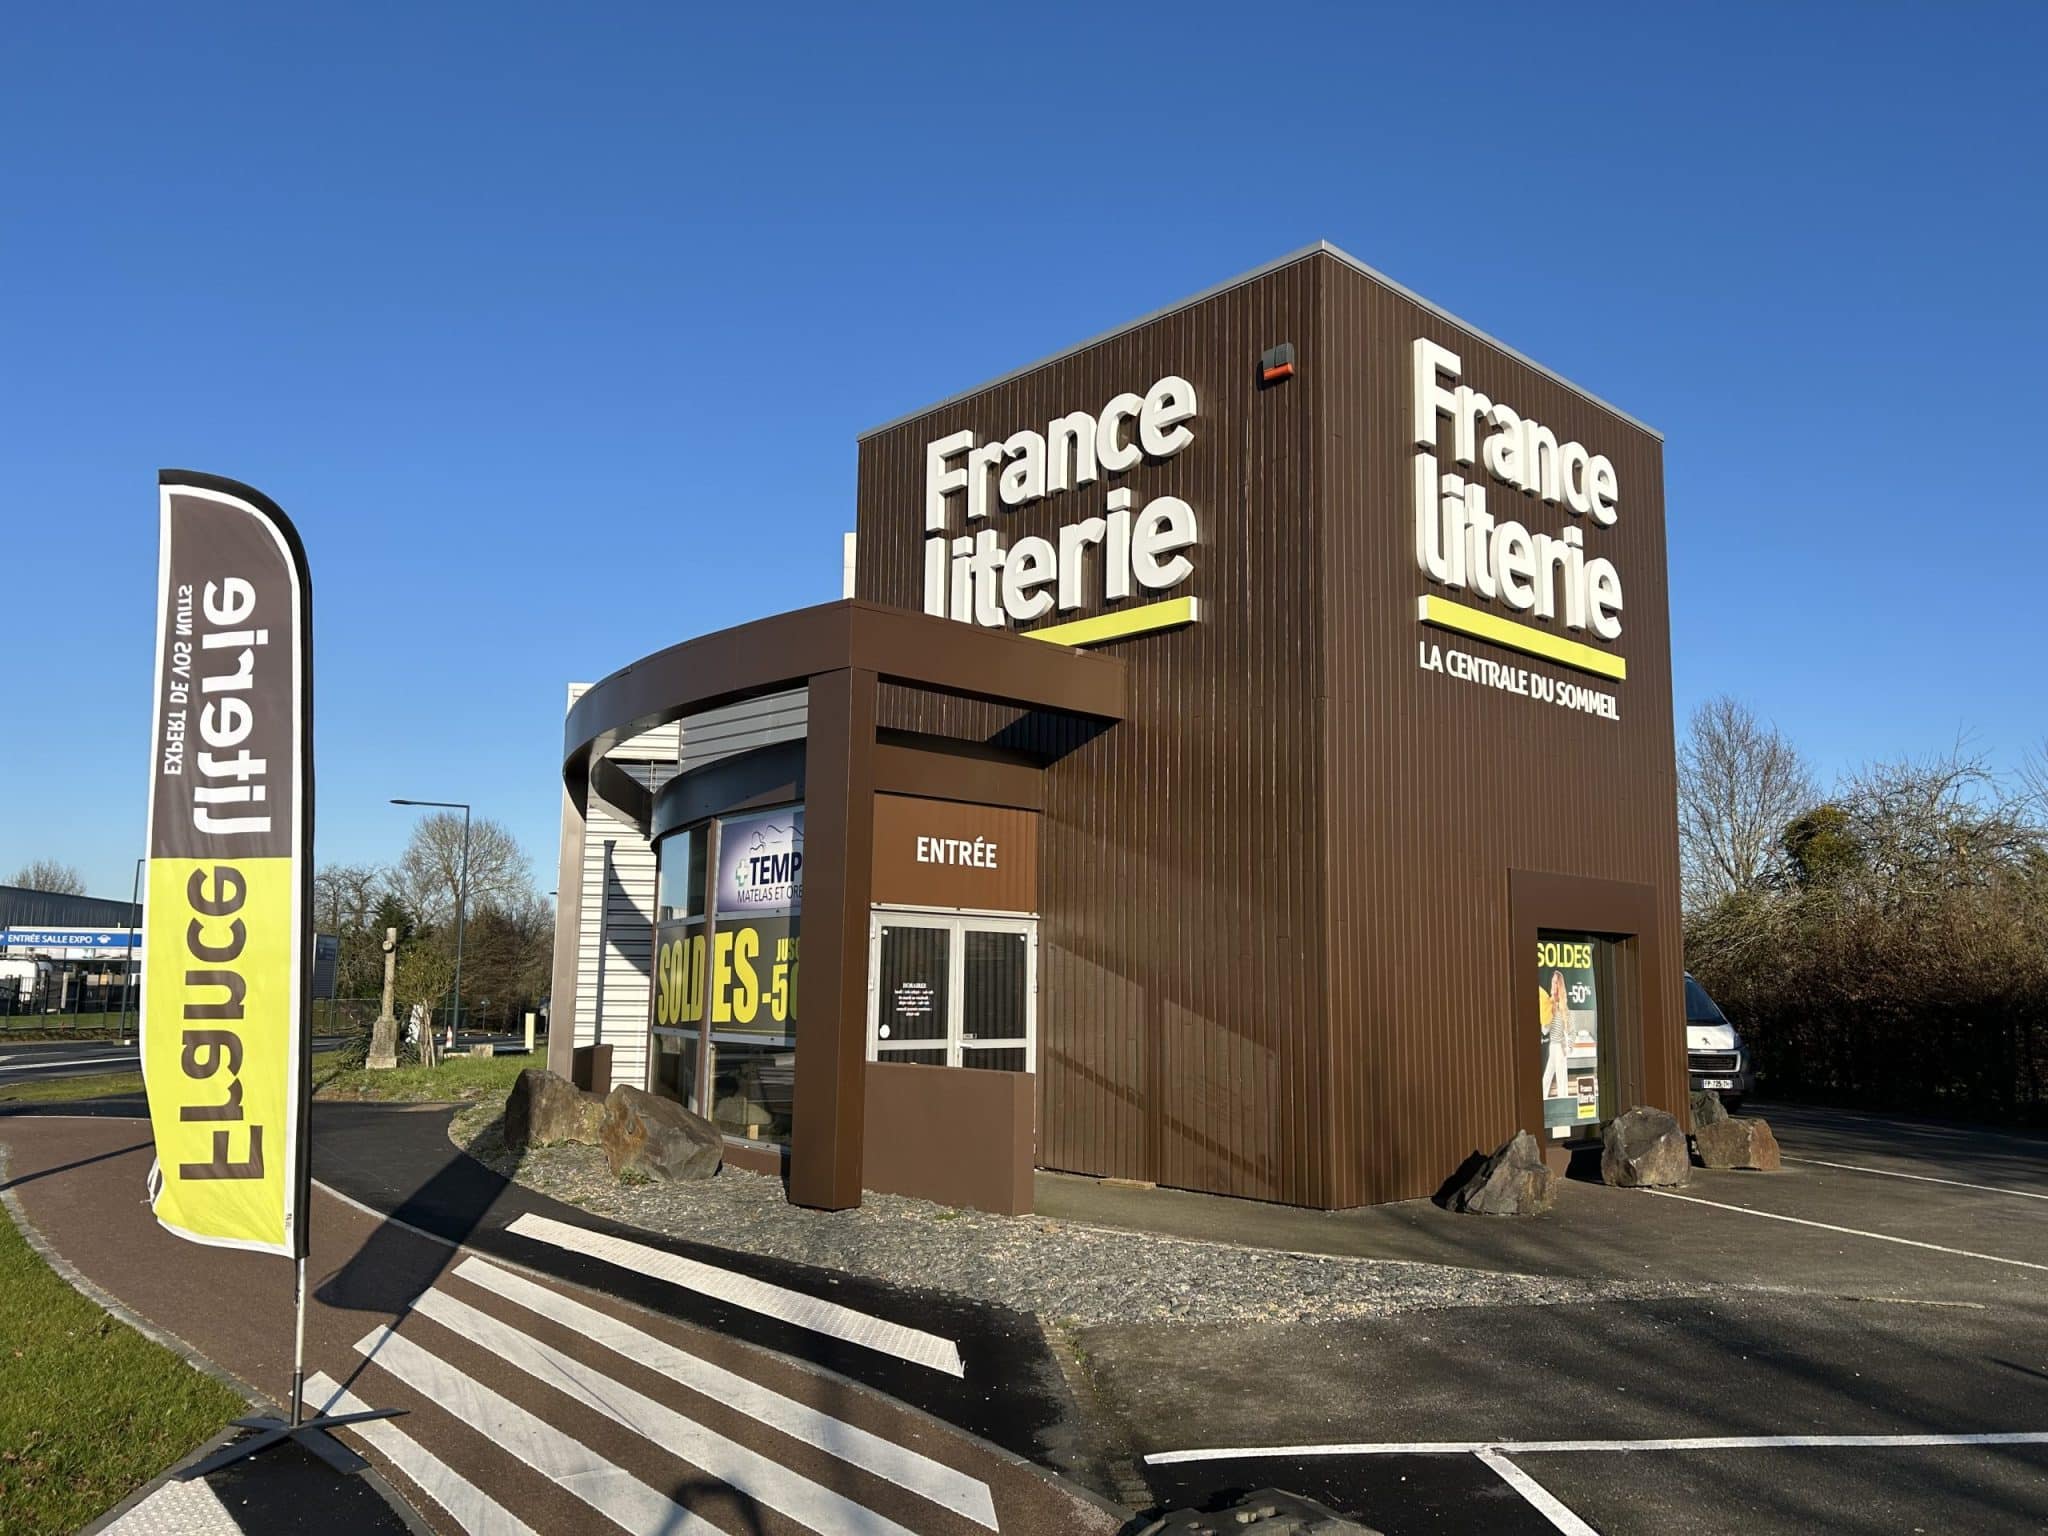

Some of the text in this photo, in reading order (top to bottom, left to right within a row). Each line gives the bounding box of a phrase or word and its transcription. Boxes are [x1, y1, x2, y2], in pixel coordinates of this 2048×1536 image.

[926, 375, 1197, 532] France
[1413, 337, 1618, 526] France
[924, 487, 1198, 628] literie
[1415, 452, 1623, 640] literie
[1420, 641, 1620, 720] LA CENTRALE DU SOMMEIL
[917, 836, 998, 869] ENTRÉE
[737, 887, 773, 904] MATELAS
[775, 886, 785, 901] ET
[7, 934, 93, 944] ENTRÉE SALLE EXPO
[1537, 942, 1591, 968] SOLDES
